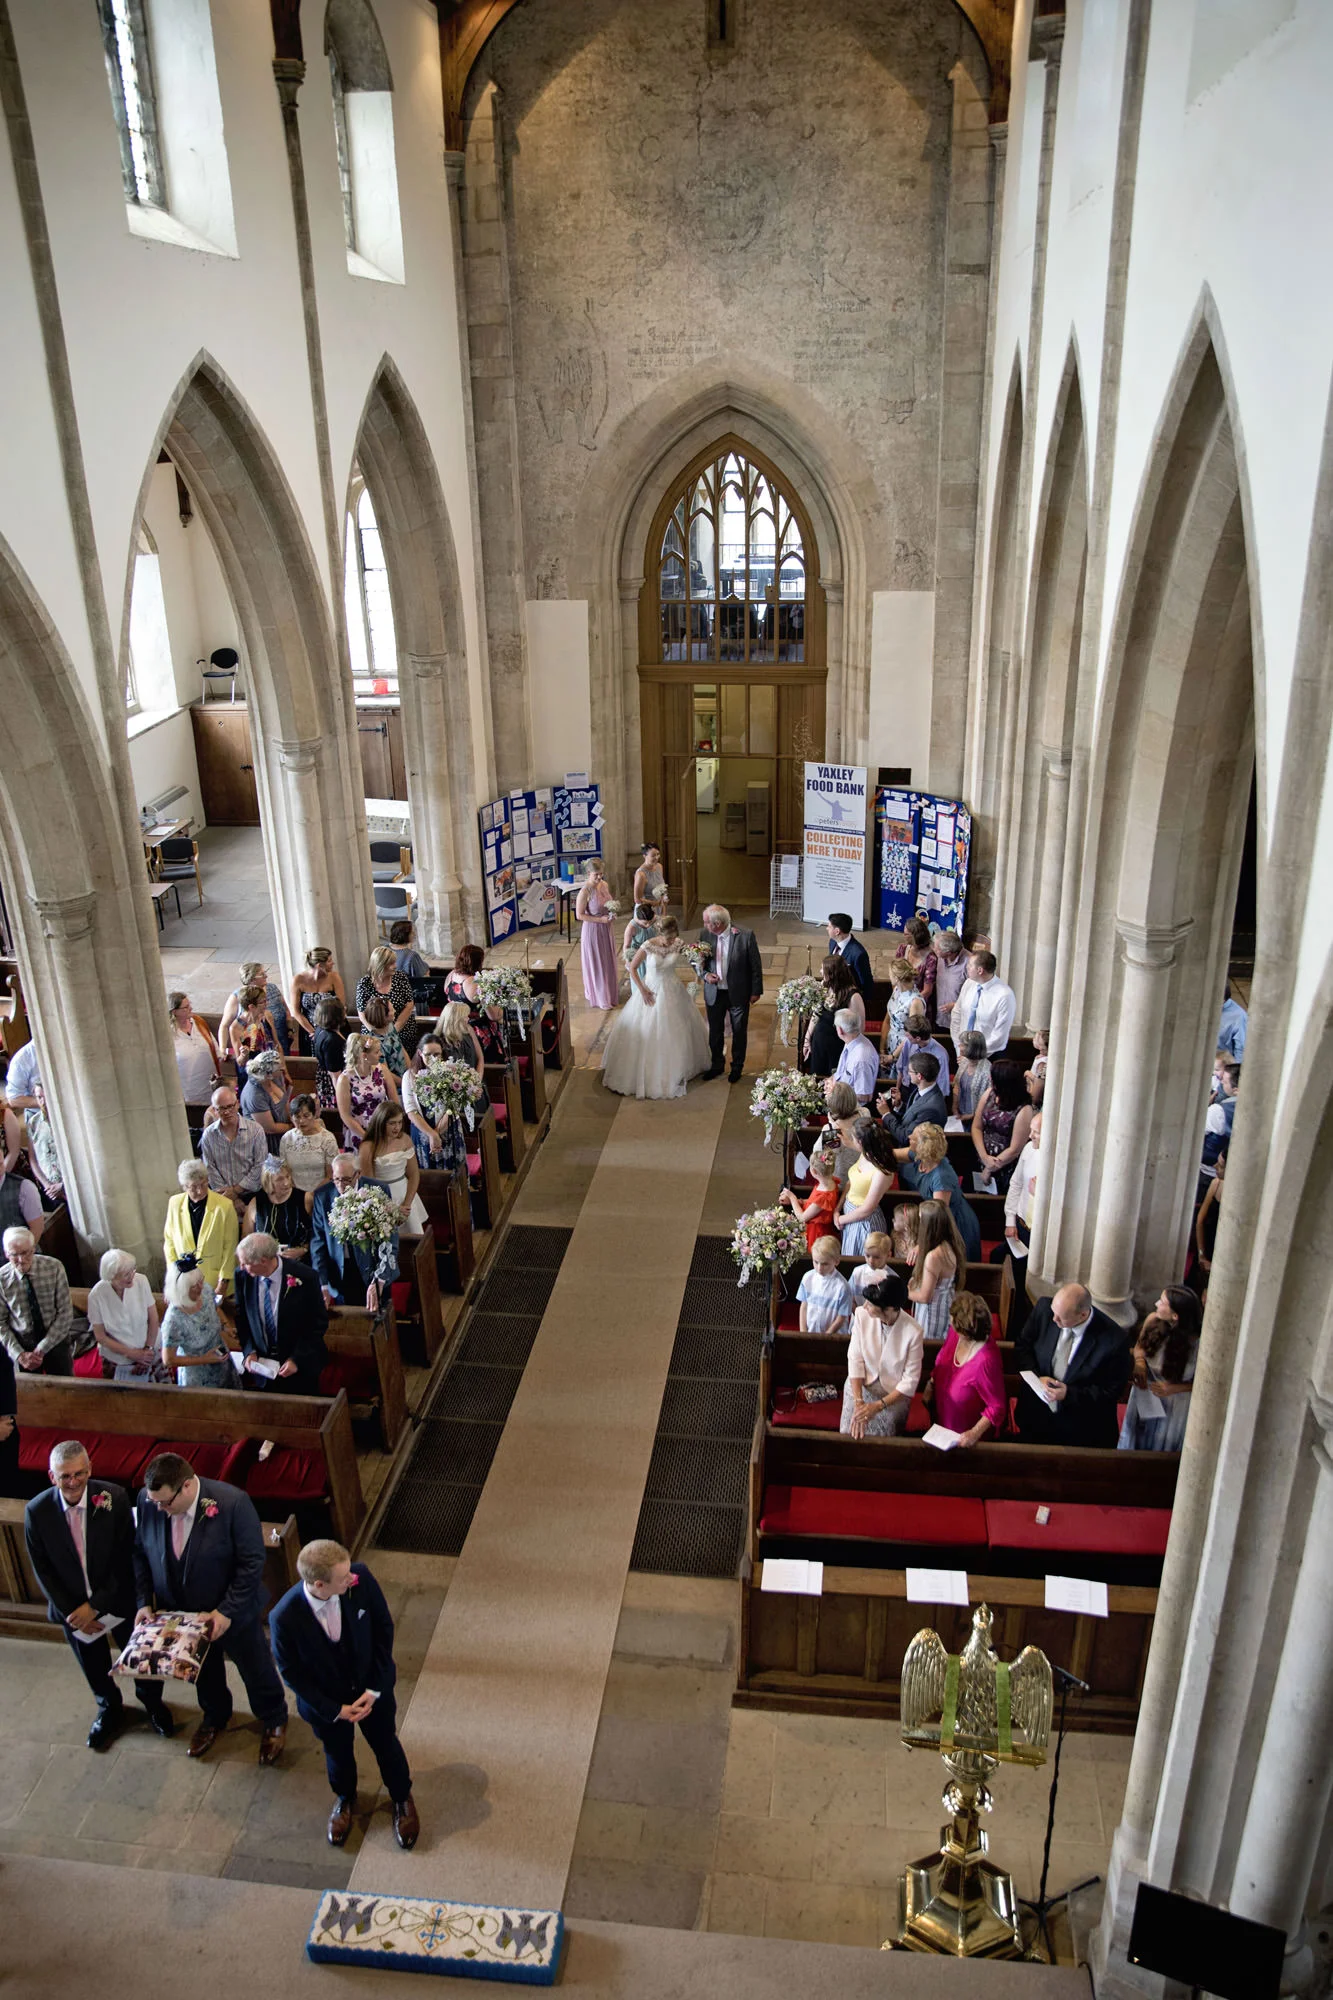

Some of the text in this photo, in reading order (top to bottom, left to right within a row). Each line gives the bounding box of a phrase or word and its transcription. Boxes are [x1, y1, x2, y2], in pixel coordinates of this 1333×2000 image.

[817, 766, 854, 780] YAXLEY
[806, 779, 864, 796] FOOD BANK
[806, 831, 863, 848] COLLECTING
[807, 844, 830, 856] HERE
[832, 846, 862, 861] TODAY
